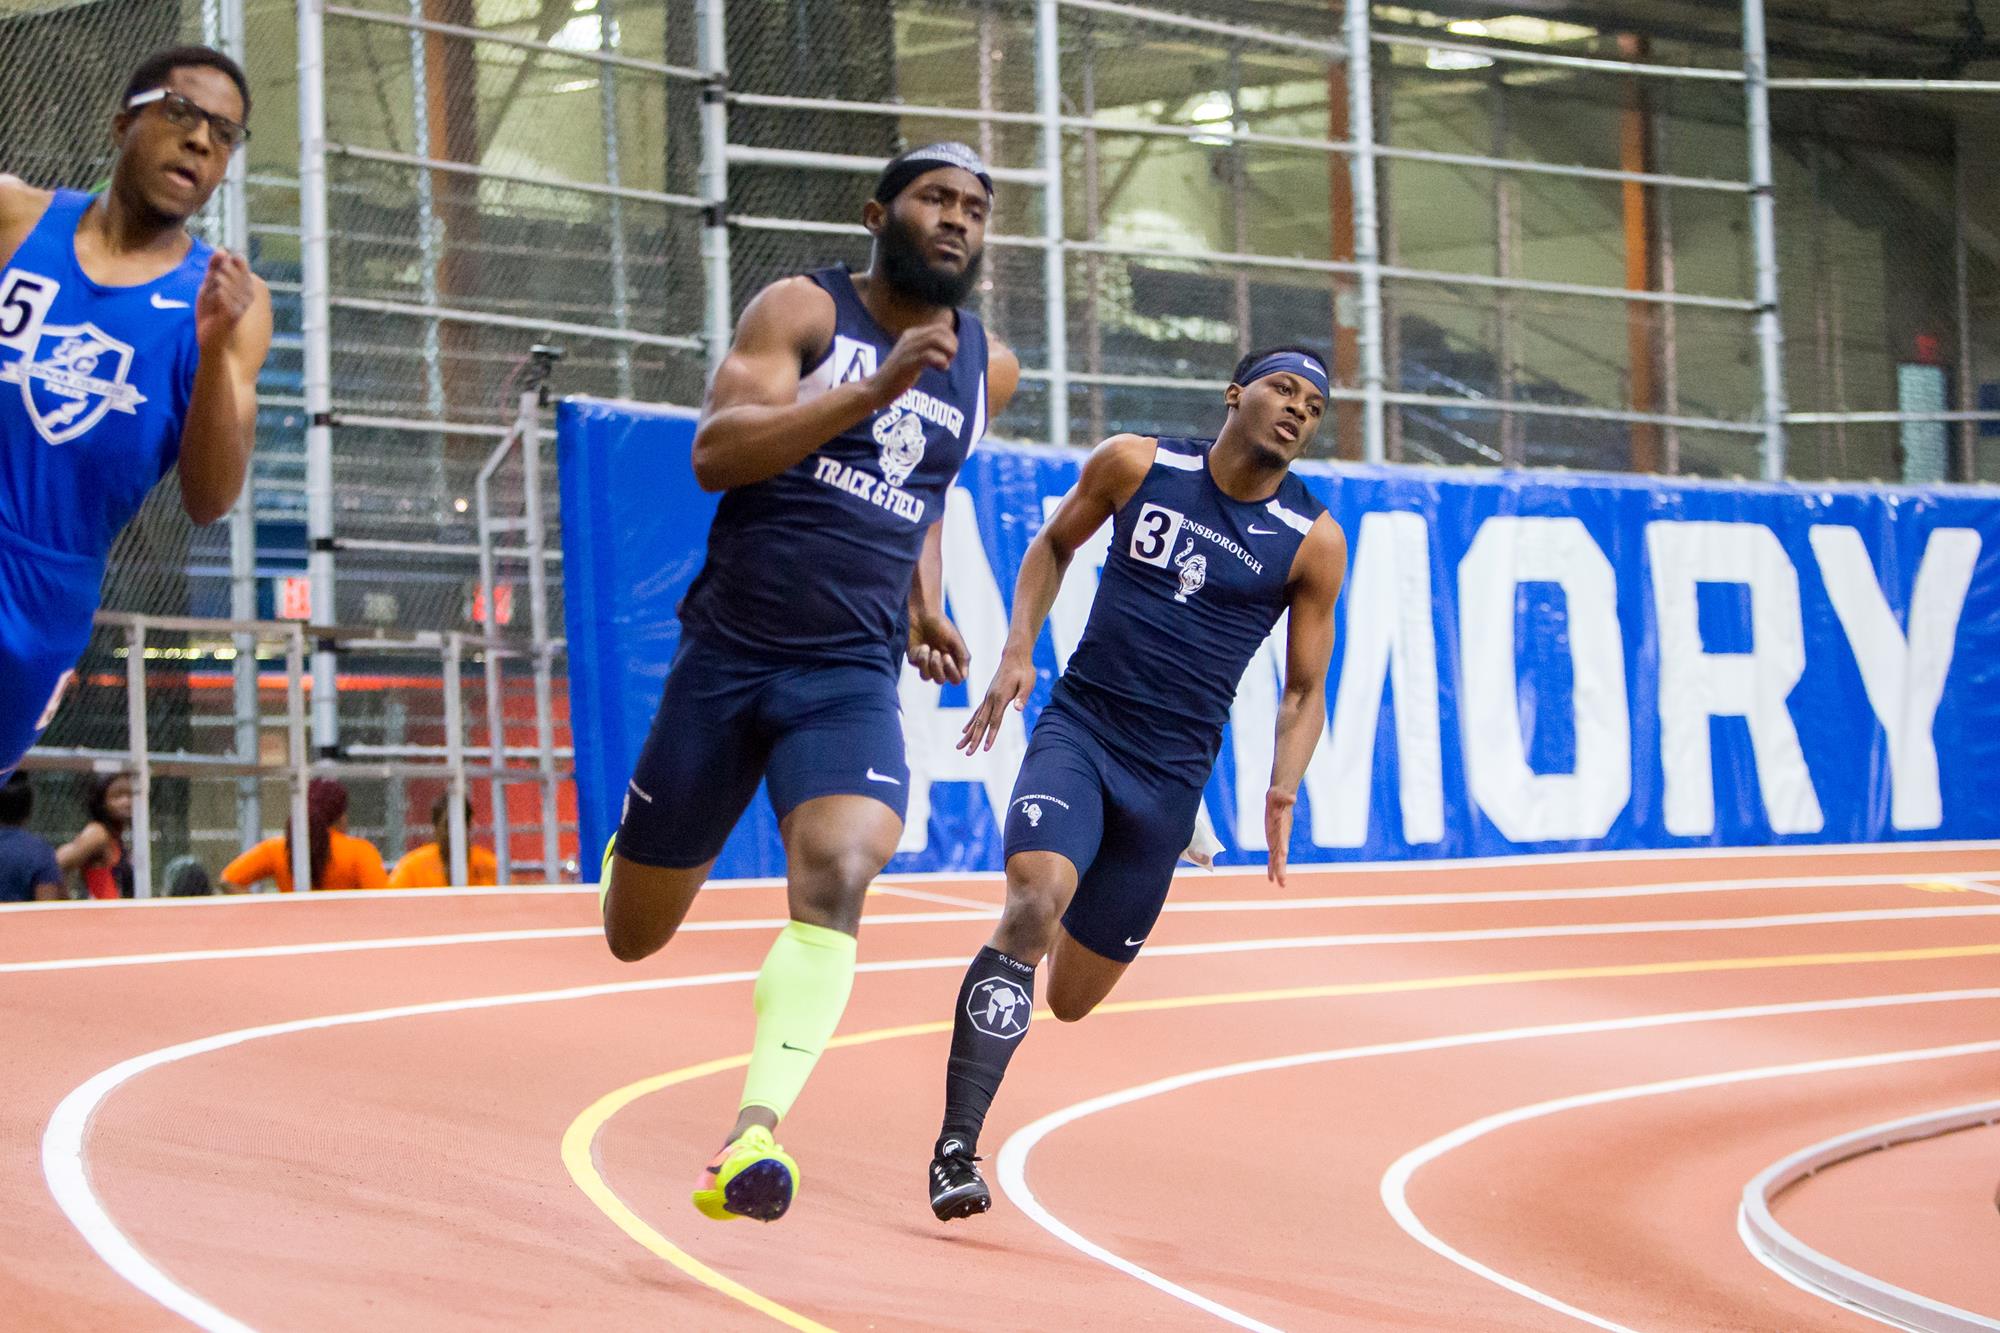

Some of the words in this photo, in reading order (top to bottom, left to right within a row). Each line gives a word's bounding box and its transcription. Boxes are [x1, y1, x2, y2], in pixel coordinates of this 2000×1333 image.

[0, 278, 43, 338] 5
[814, 456, 877, 501] TRACK
[883, 486, 925, 524] FIELD
[1135, 510, 1172, 560] 3
[897, 486, 1982, 853] AMORY
